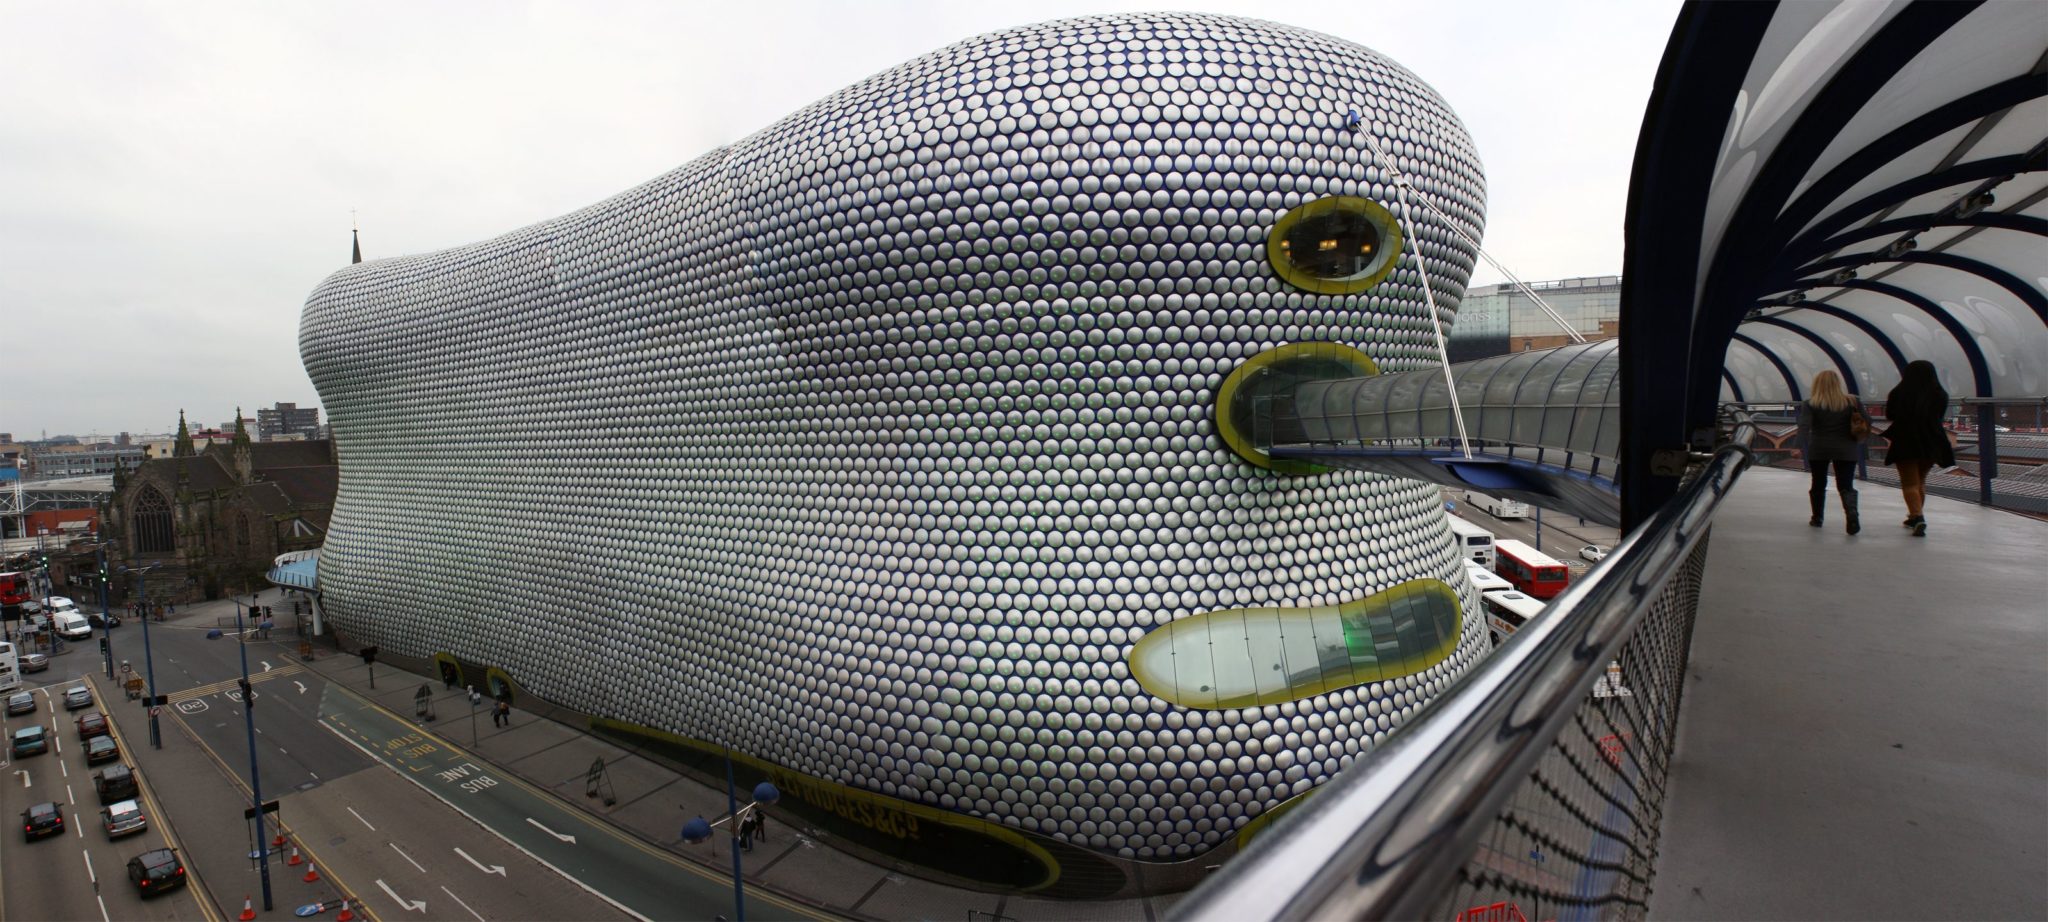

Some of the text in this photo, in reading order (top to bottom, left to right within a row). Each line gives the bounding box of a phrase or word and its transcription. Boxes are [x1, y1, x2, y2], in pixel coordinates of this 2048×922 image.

[387, 733, 422, 748] STOP
[404, 743, 436, 758] BUS
[435, 763, 481, 783] LANE
[461, 775, 498, 793] BUS
